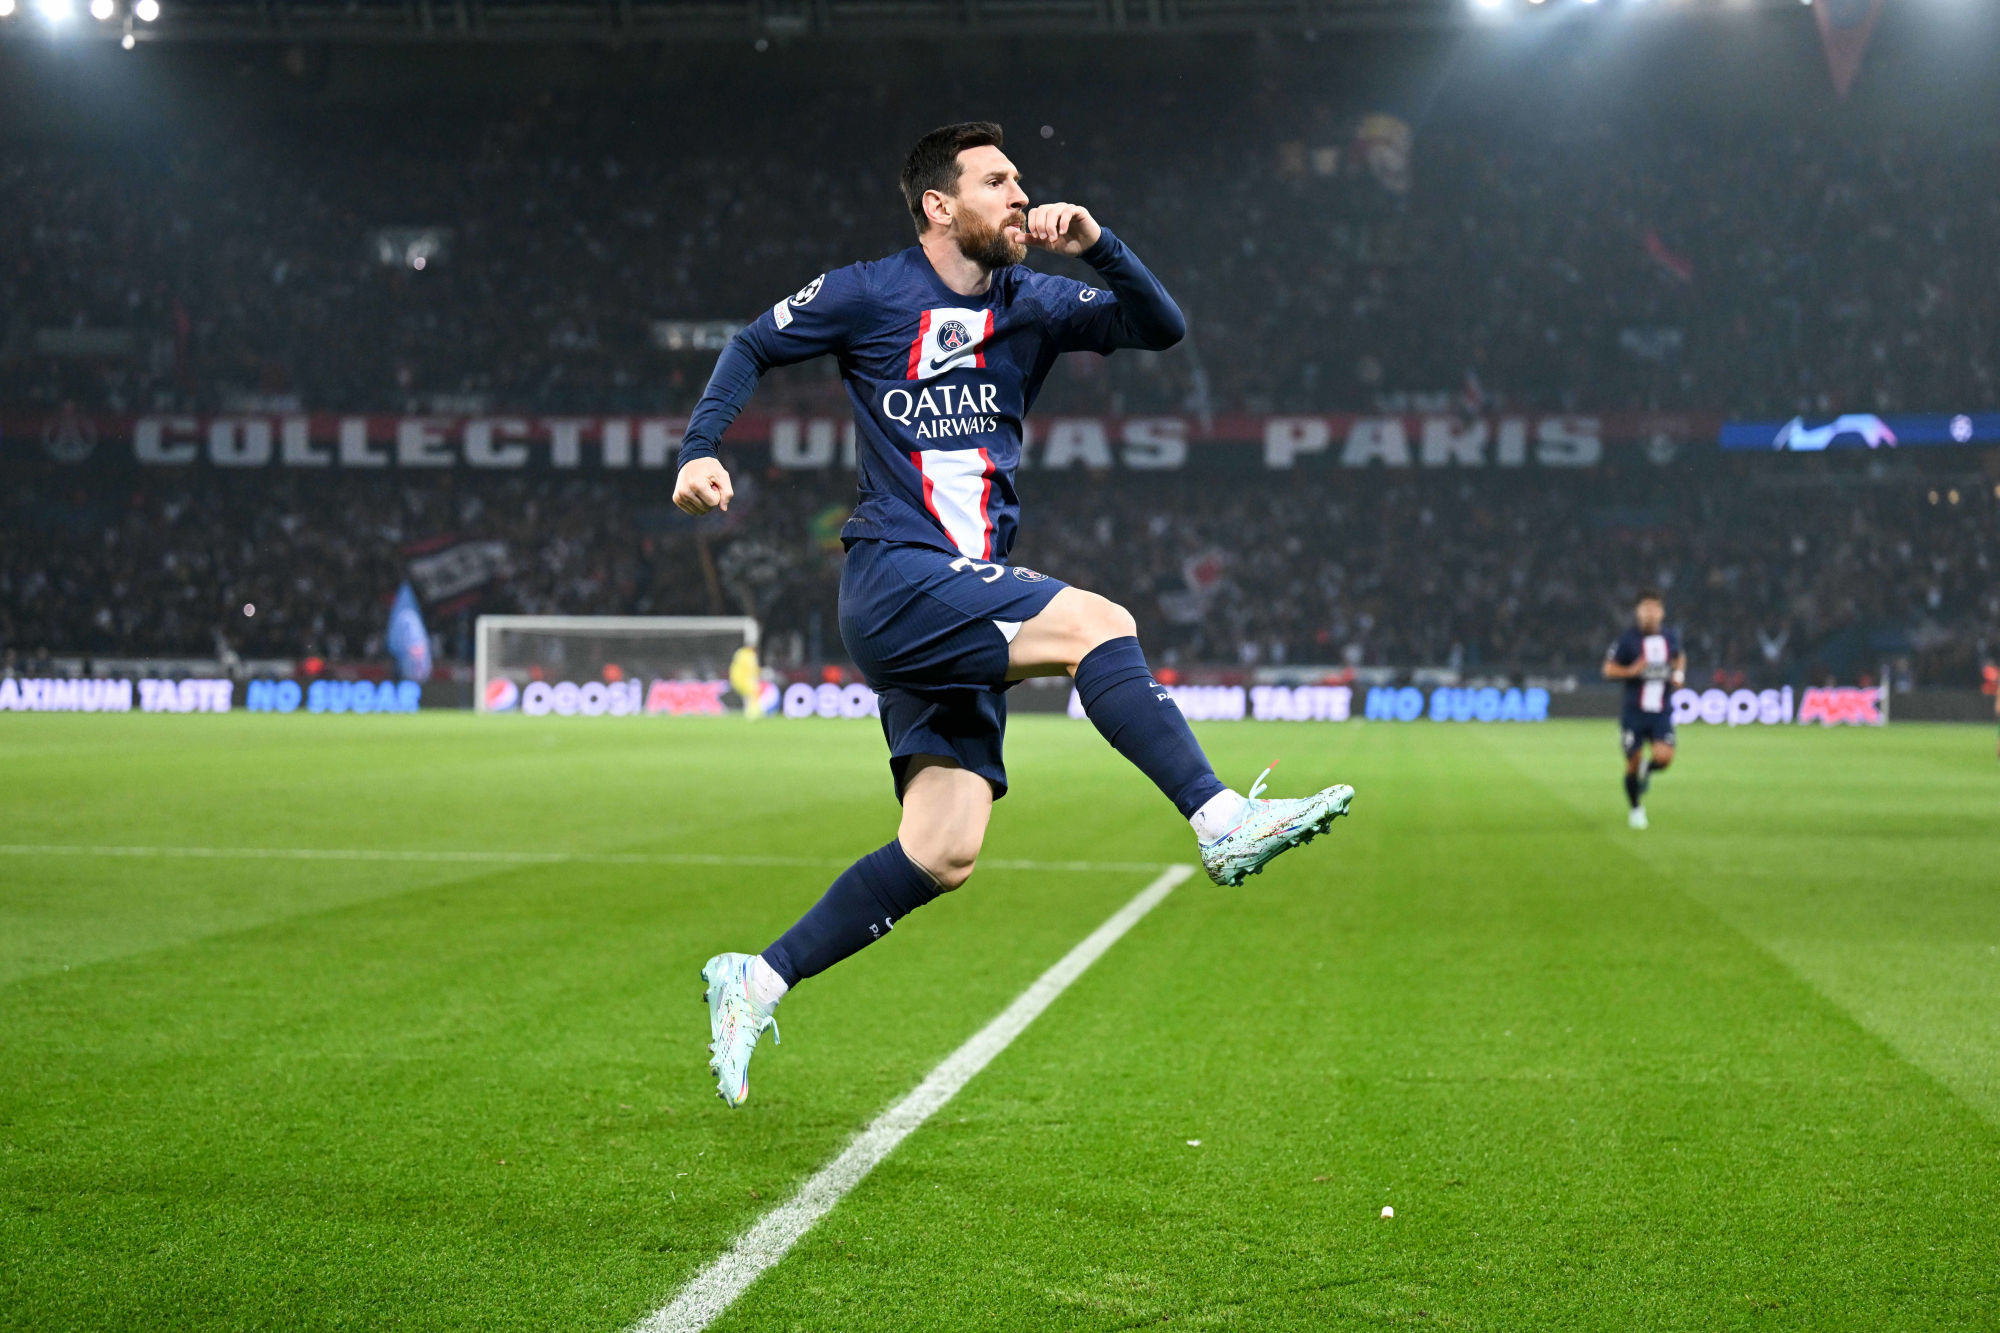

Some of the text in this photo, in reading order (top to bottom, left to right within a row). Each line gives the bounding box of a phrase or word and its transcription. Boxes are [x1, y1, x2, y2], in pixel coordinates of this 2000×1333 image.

[882, 383, 1001, 427] QATAR
[134, 417, 687, 469] COLLECTIF
[1264, 417, 1600, 468] PARIS
[916, 415, 999, 440] AIRWAYS
[0, 678, 234, 713] AXIMUM TASTE
[247, 680, 422, 714] NO SUGAR
[1250, 685, 1352, 721] TASTE
[1365, 686, 1549, 722] NO SUGAR
[1670, 684, 1794, 727] pepsi
